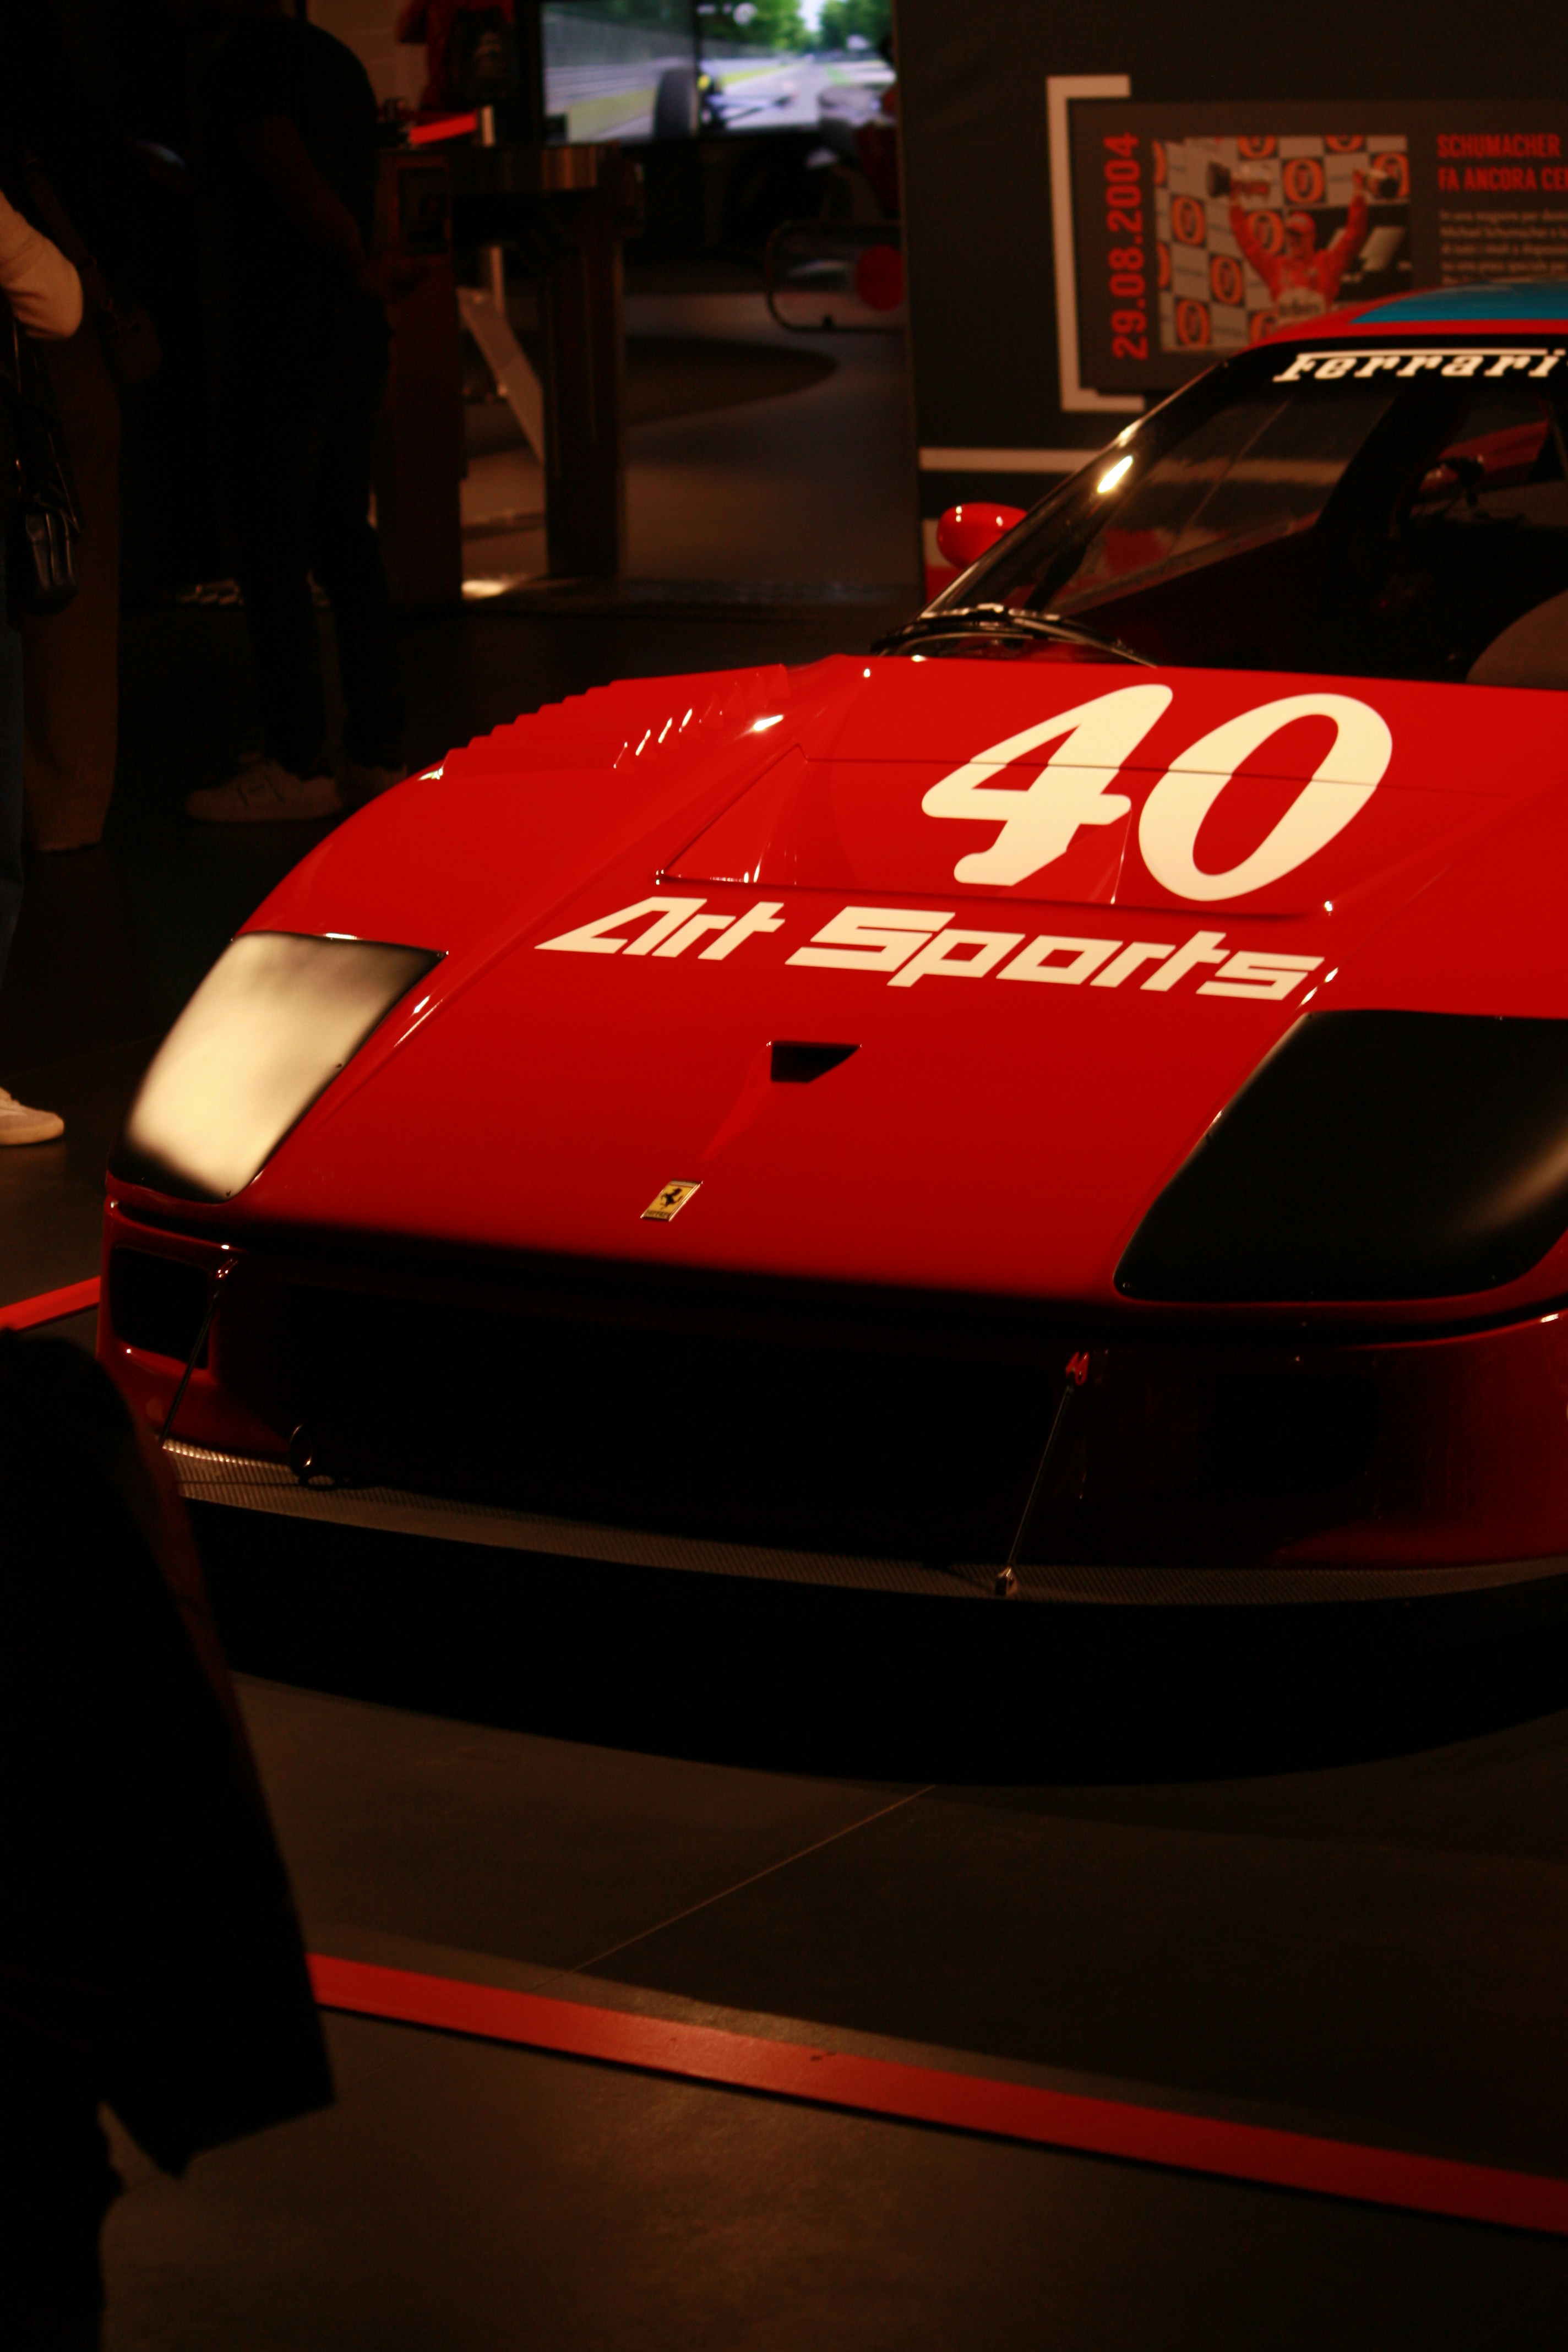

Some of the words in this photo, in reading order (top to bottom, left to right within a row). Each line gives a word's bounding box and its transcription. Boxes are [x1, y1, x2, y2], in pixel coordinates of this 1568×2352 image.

[1436, 133, 1561, 159] SCHUMACHER
[1438, 166, 1460, 191] FA
[1463, 166, 1538, 192] ANCORA
[1102, 131, 1148, 361] 29.08.2004
[1272, 347, 1567, 383] Ferrari
[921, 684, 1392, 901] 40
[535, 896, 785, 960] Art
[785, 906, 1325, 1000] Sports
